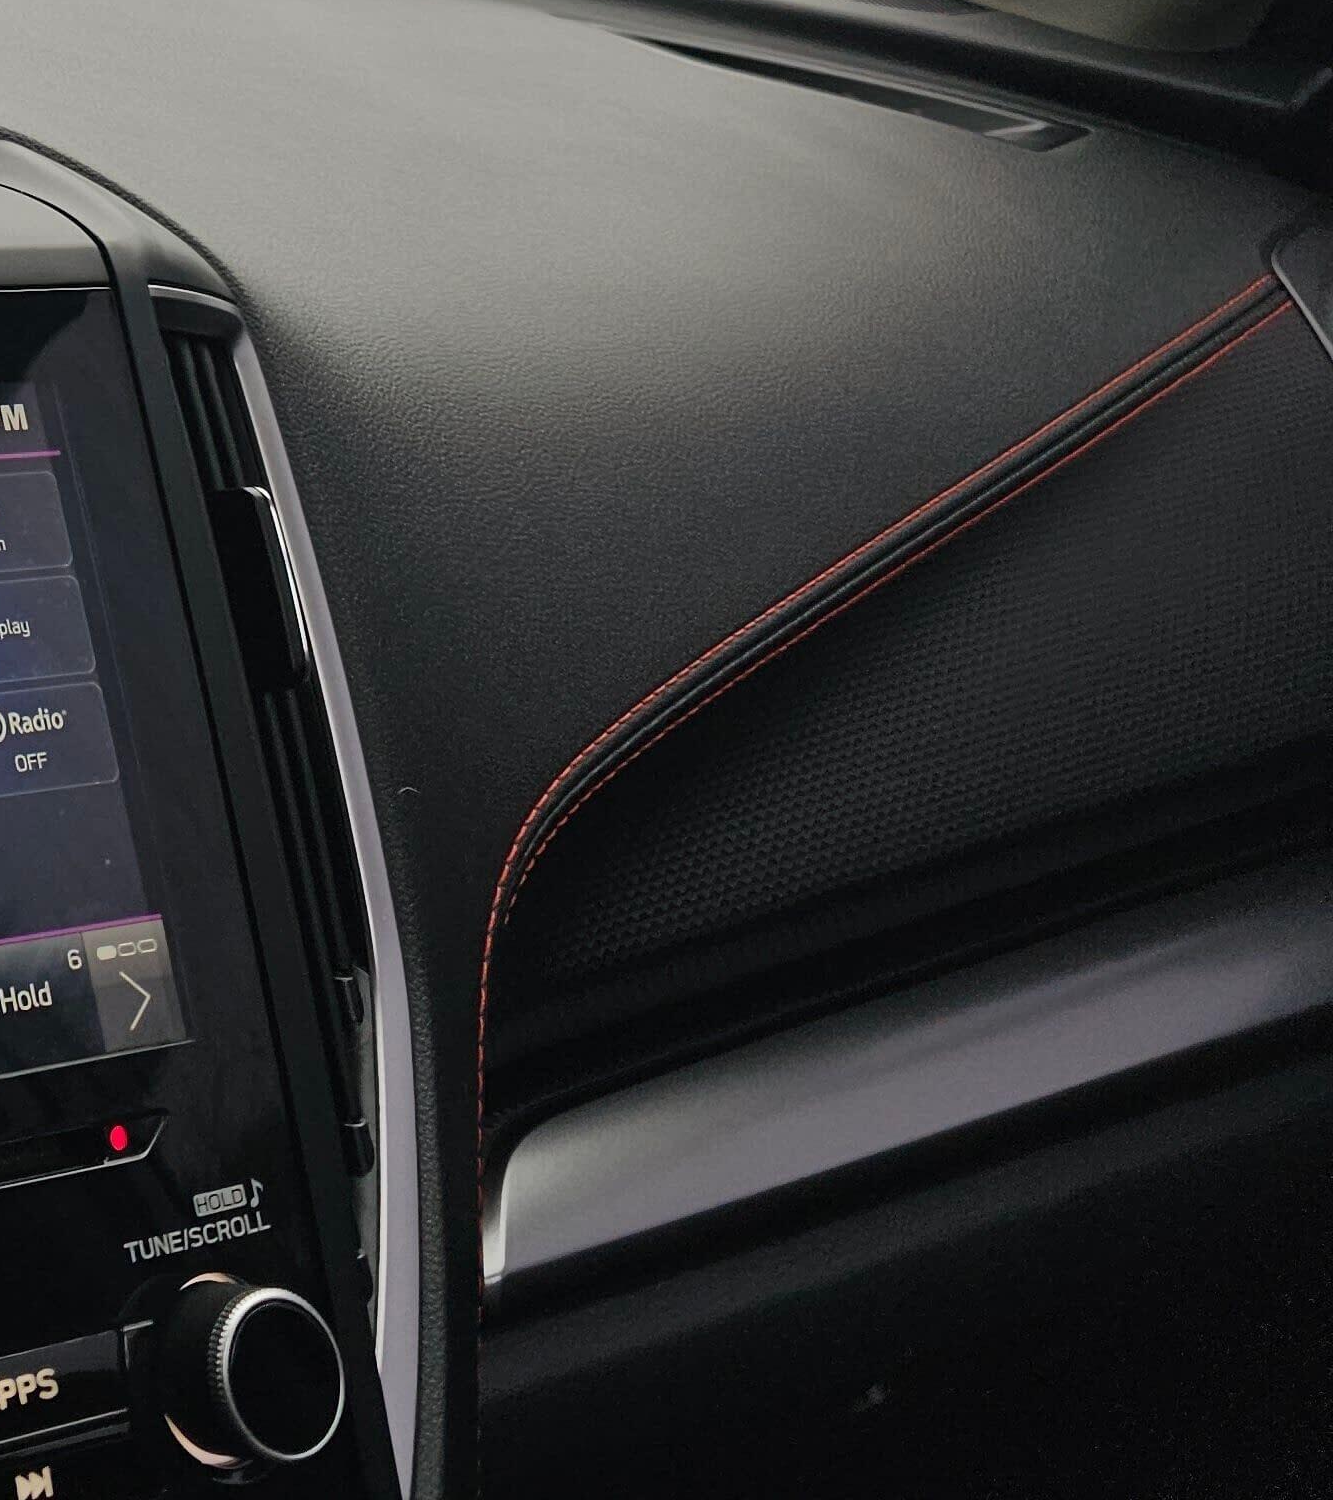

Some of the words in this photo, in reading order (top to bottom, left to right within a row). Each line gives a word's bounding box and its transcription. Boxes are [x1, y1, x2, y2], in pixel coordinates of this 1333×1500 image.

[7, 706, 65, 736] Radio
[14, 751, 48, 773] OFF
[66, 948, 83, 970] 6
[196, 1189, 244, 1214] HOLD
[124, 1211, 271, 1264] TUNE/SCROLL
